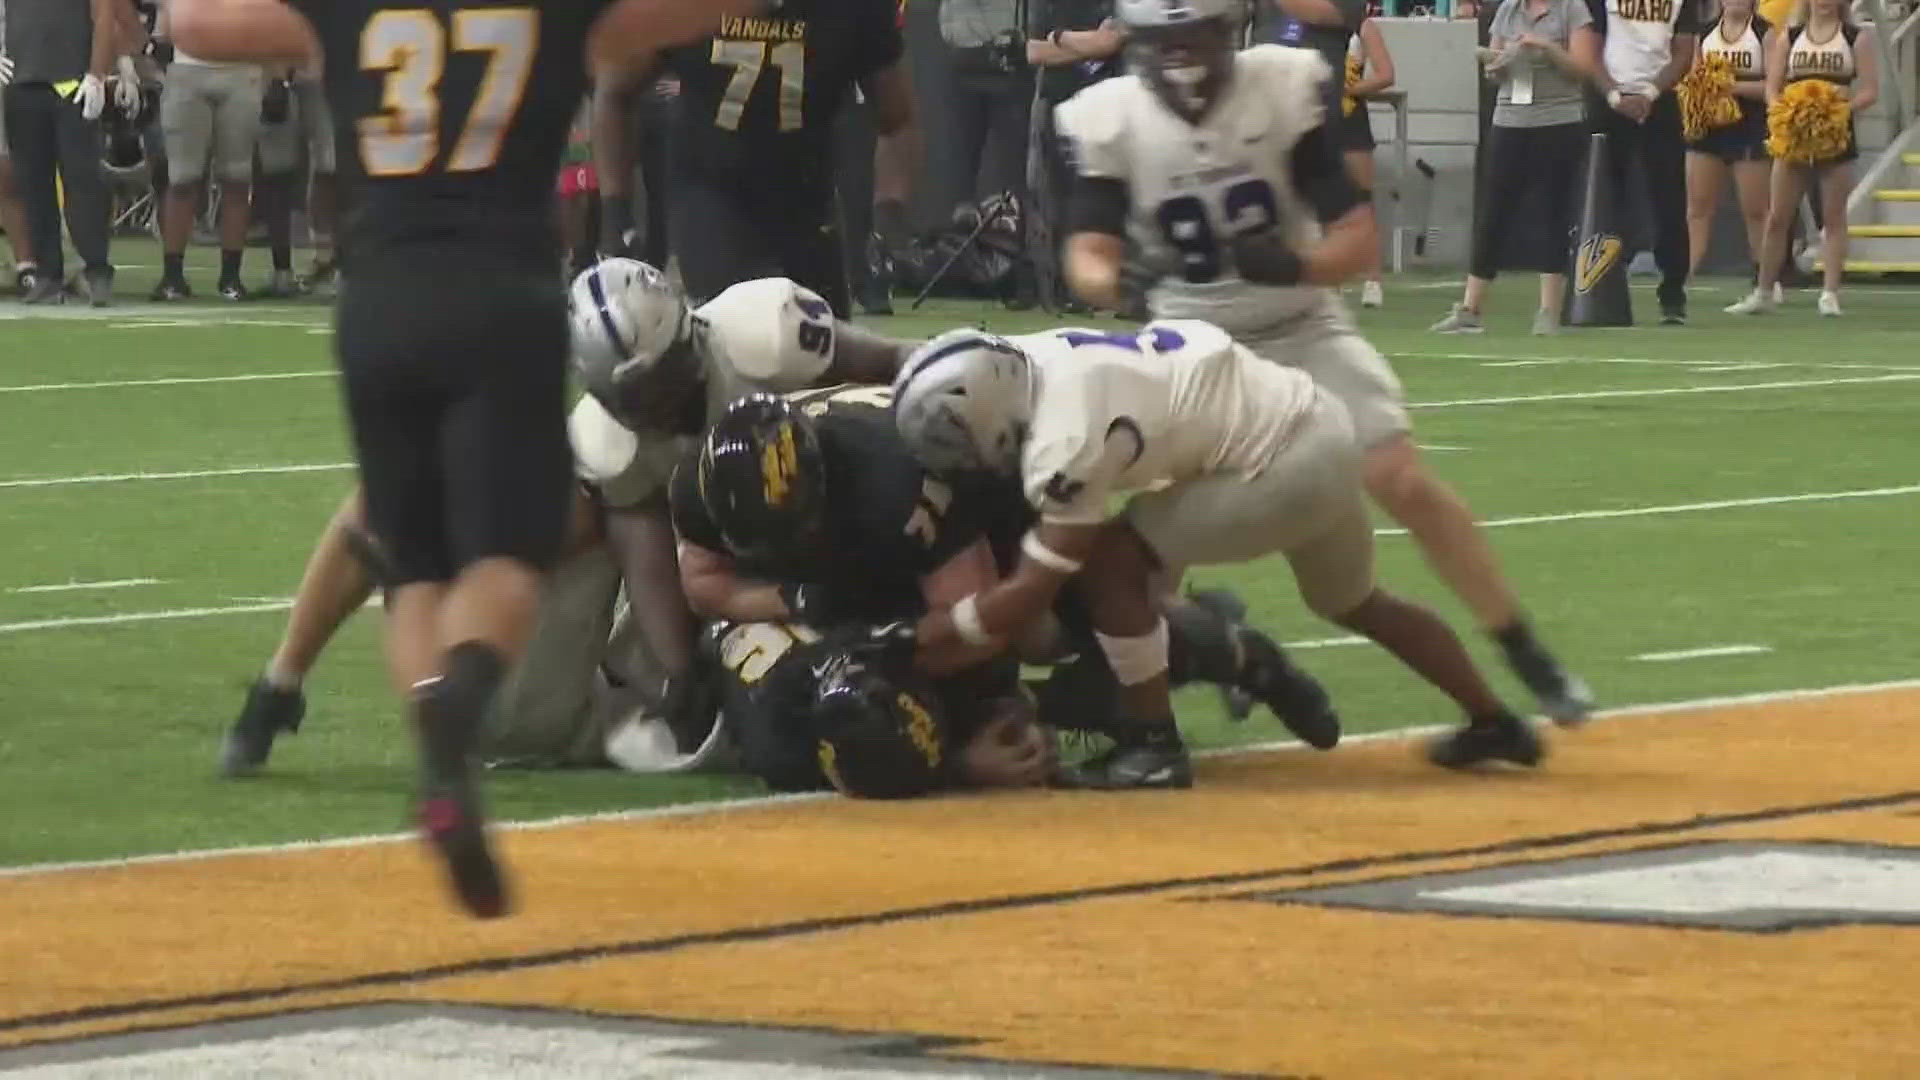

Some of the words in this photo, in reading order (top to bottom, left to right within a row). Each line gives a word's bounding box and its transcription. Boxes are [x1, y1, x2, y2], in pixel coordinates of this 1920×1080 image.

[719, 14, 806, 39] VANDALS
[710, 37, 805, 131] 71
[1792, 51, 1844, 72] IDAHO
[358, 8, 541, 177] 37
